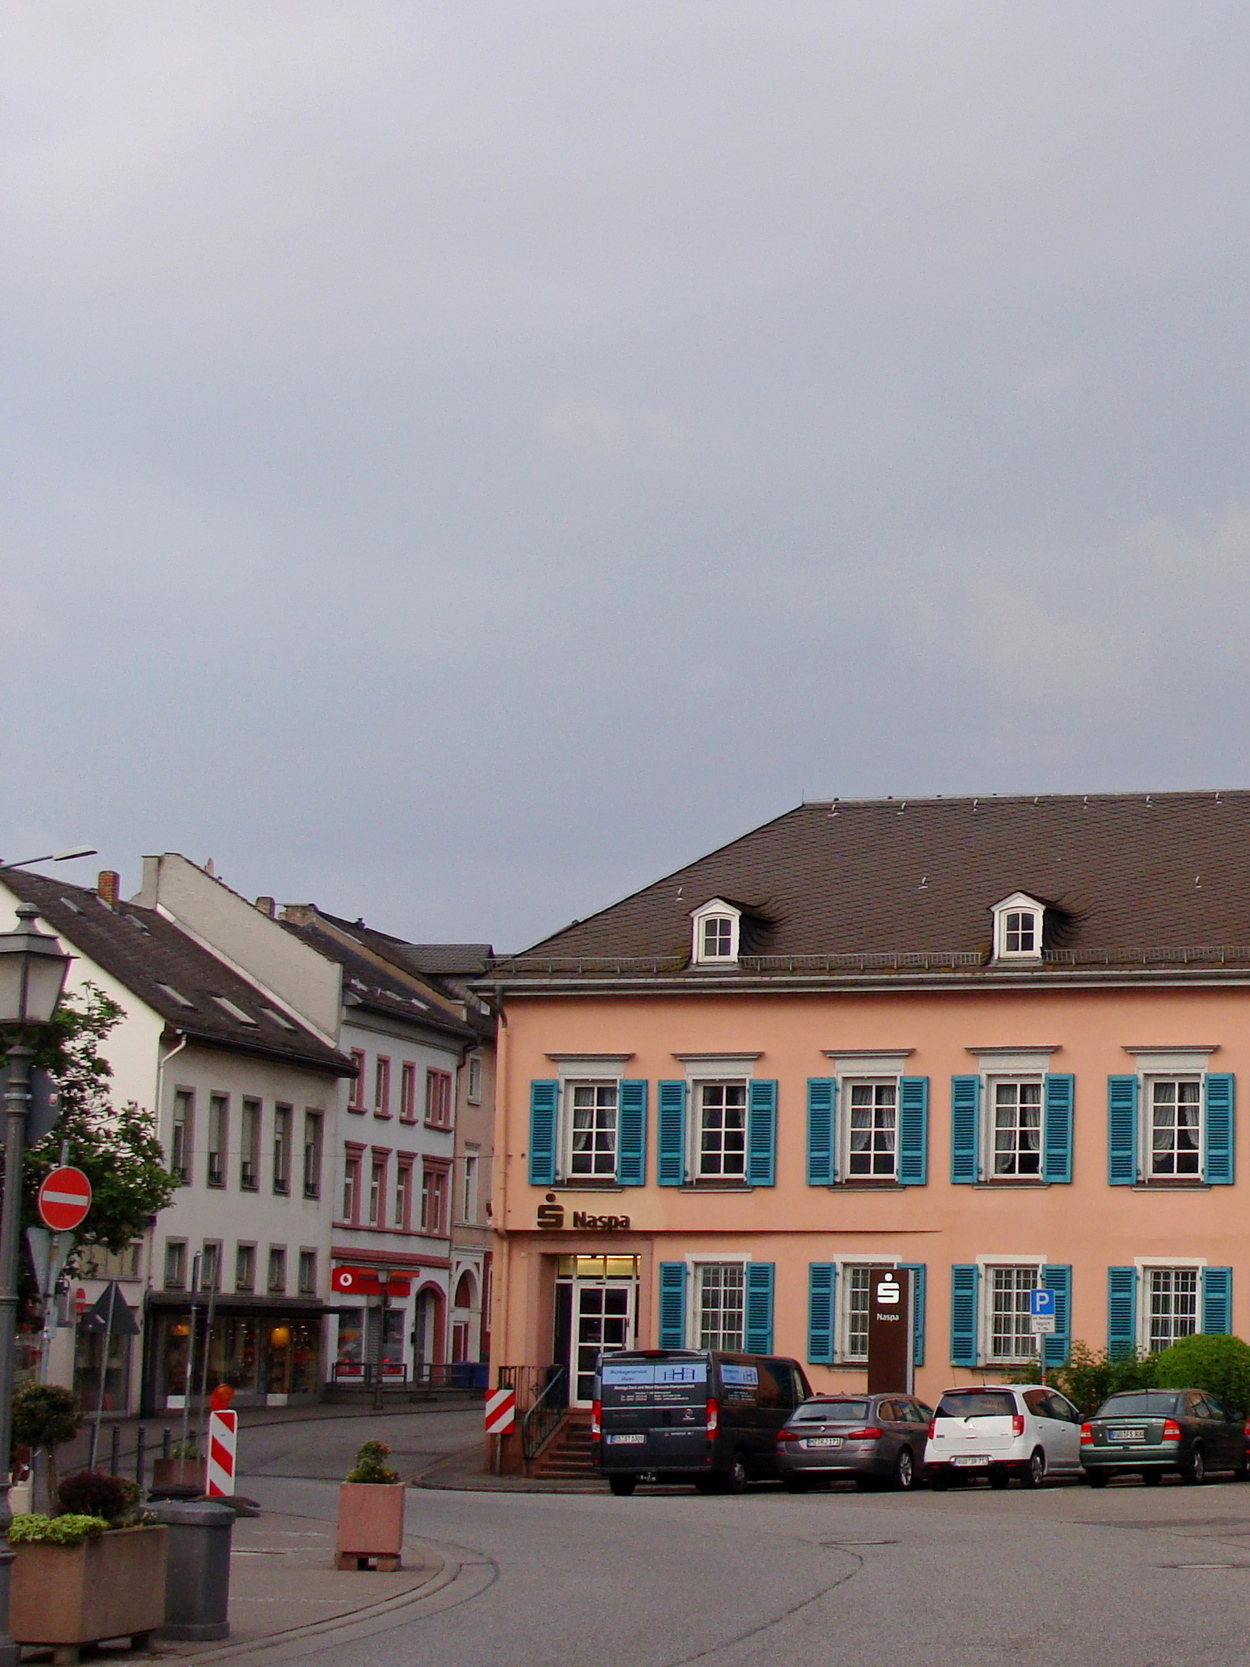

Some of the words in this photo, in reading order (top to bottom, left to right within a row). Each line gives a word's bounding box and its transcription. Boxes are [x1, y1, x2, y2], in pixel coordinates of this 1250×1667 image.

[572, 1211, 631, 1233] Naspa
[1036, 1292, 1050, 1312] P
[876, 1313, 900, 1322] Naspa
